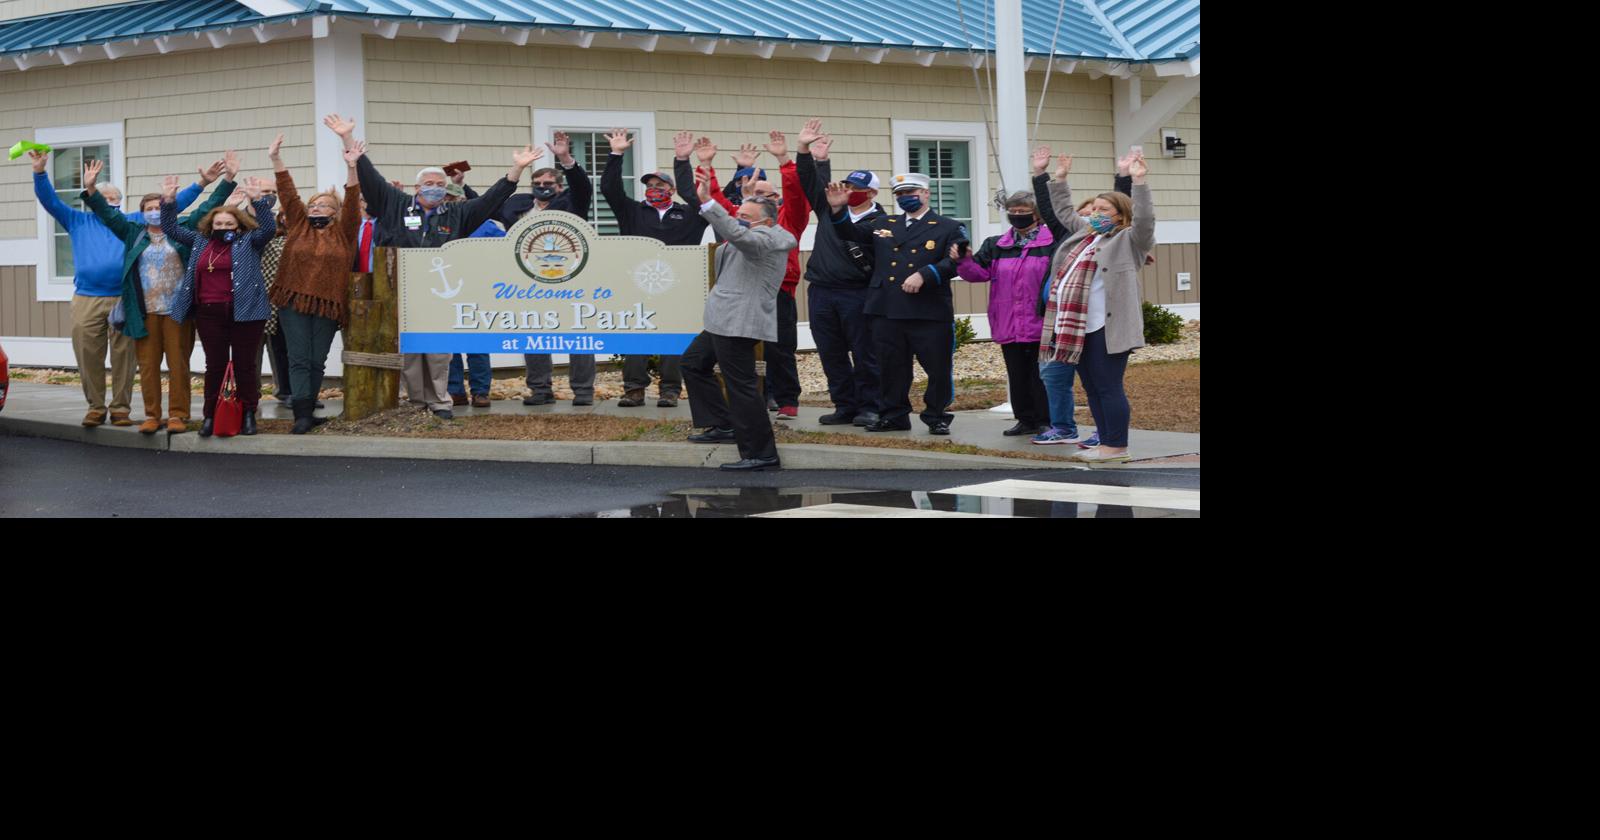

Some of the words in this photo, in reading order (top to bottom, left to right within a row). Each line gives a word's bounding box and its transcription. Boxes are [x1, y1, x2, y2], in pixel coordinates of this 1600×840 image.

[492, 282, 584, 299] Welcome
[593, 283, 612, 299] to
[452, 303, 560, 330] Evans
[571, 303, 657, 330] Park
[502, 338, 519, 350] at
[525, 336, 605, 350] Millville
